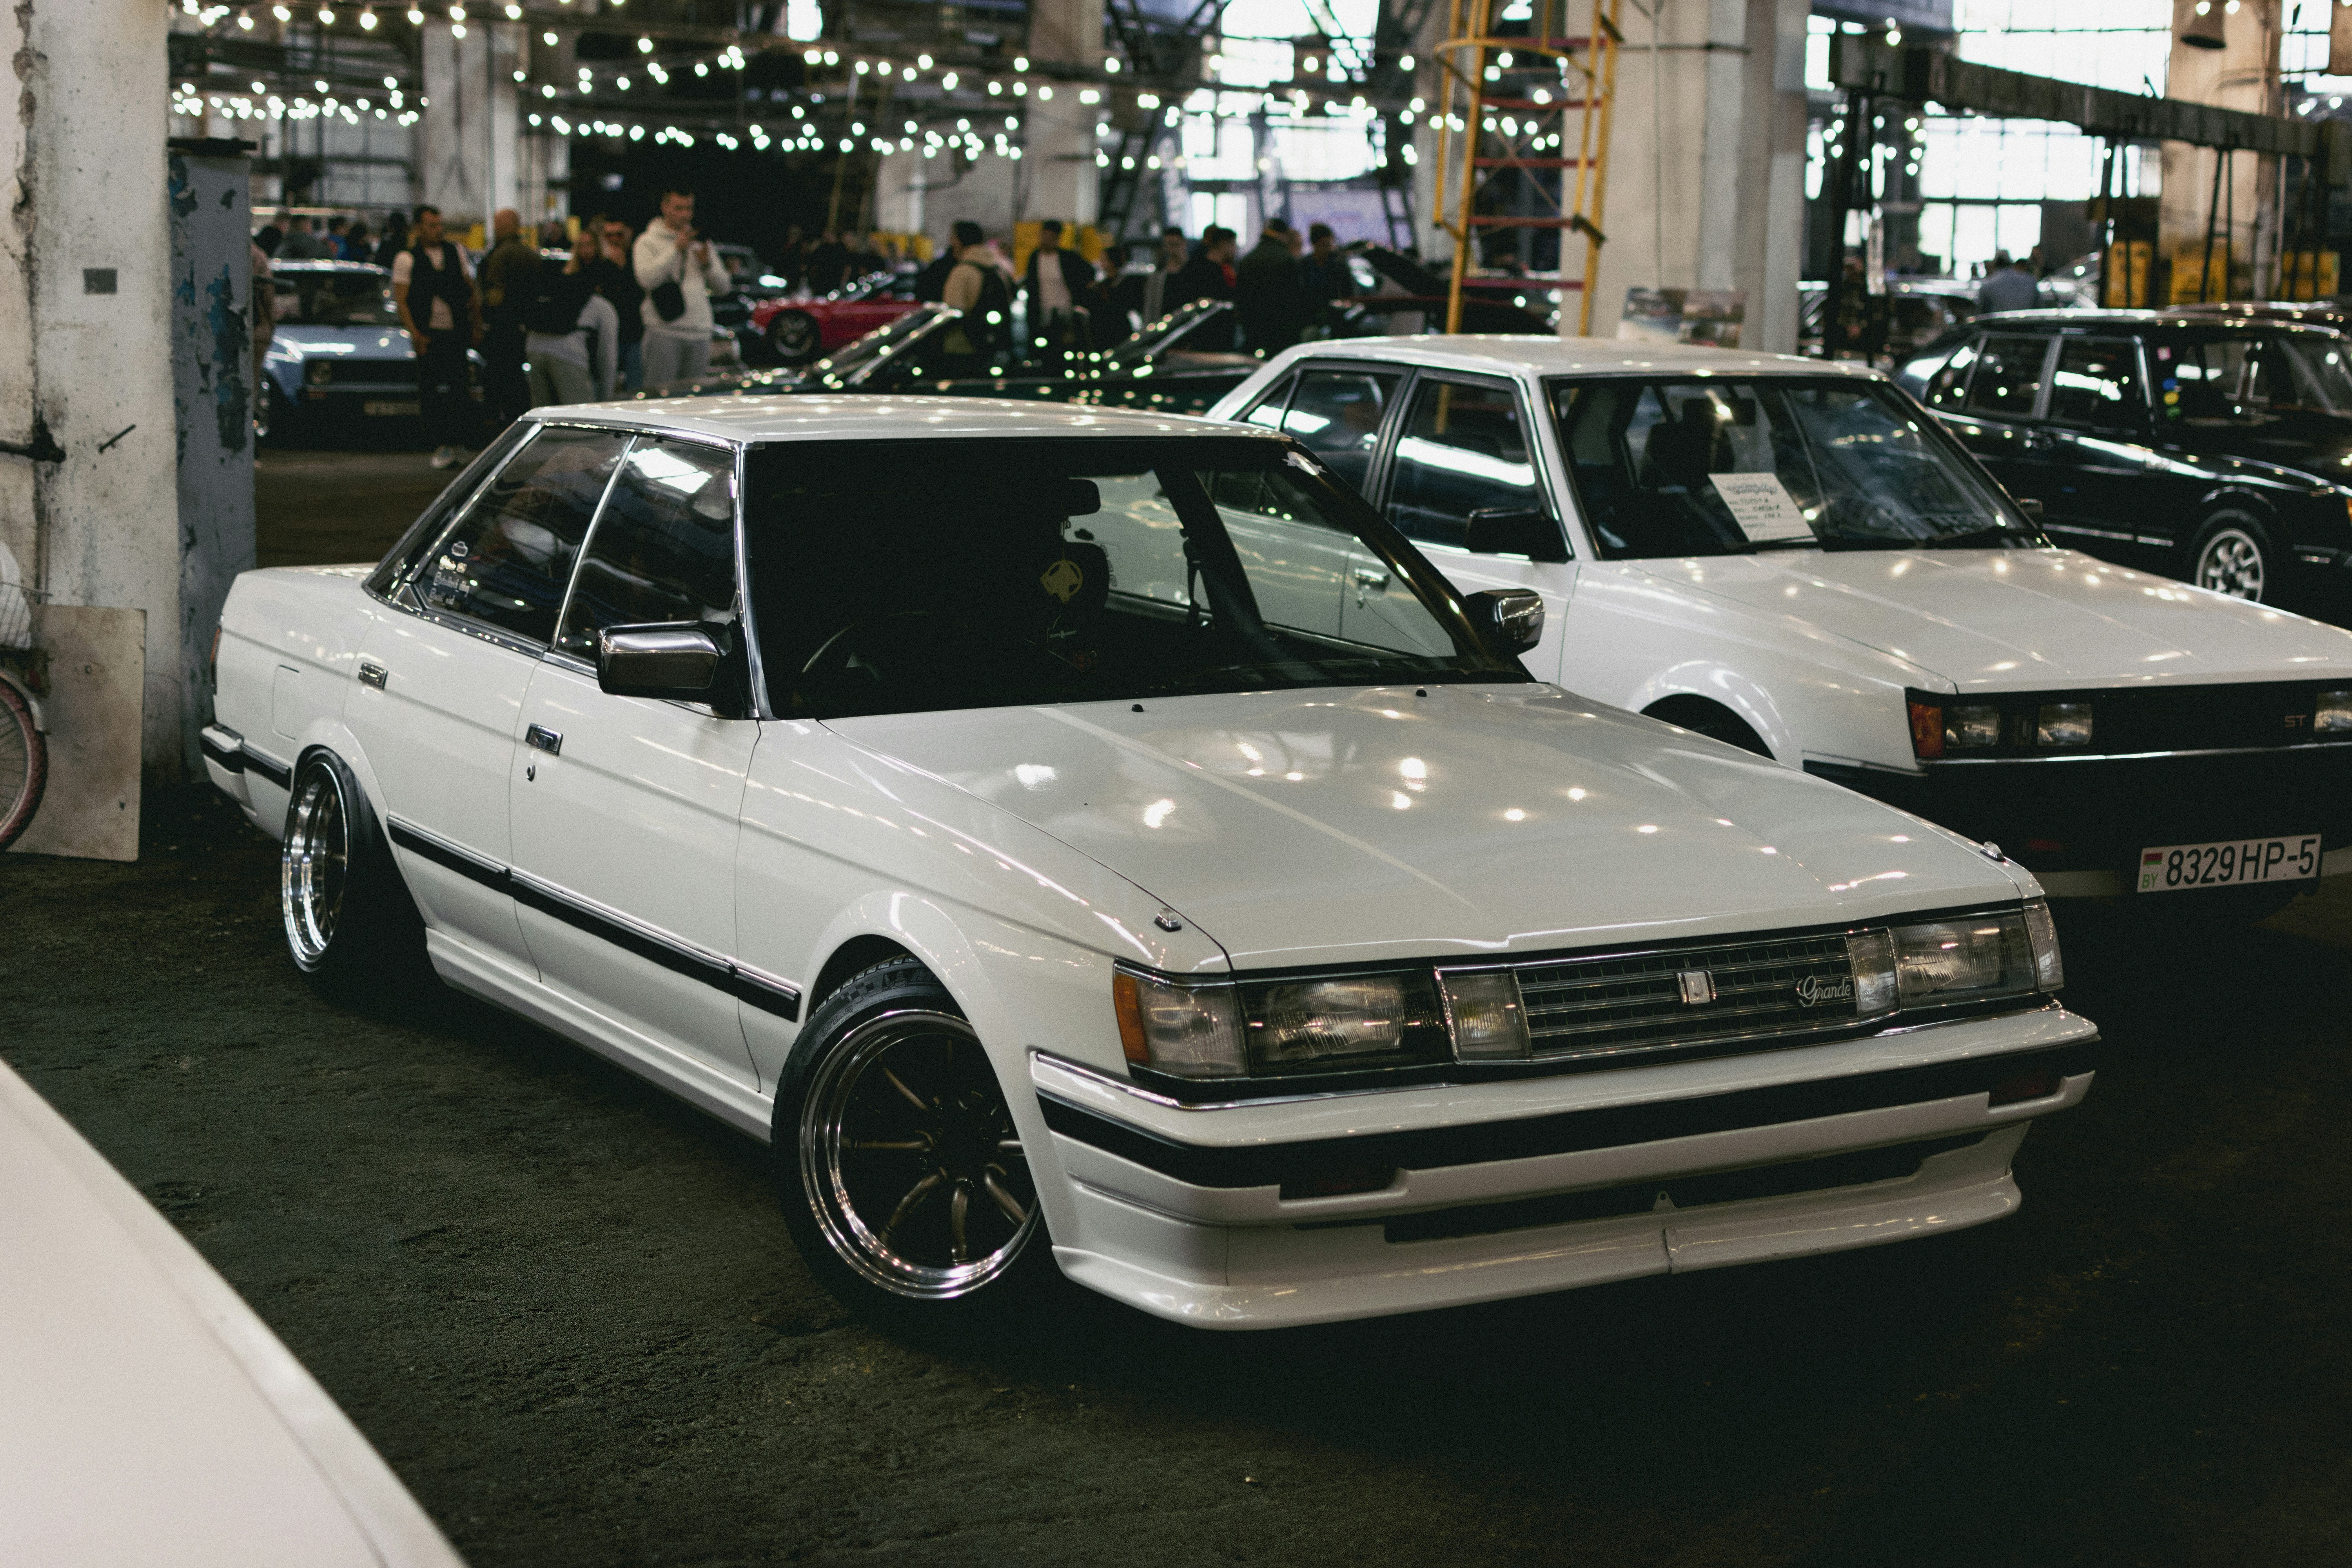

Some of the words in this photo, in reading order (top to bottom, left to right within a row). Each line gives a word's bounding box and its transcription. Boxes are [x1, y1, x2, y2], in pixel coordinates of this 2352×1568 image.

[2285, 715, 2307, 728] ST
[2141, 873, 2158, 889] BY
[1796, 975, 1851, 1007] Grande
